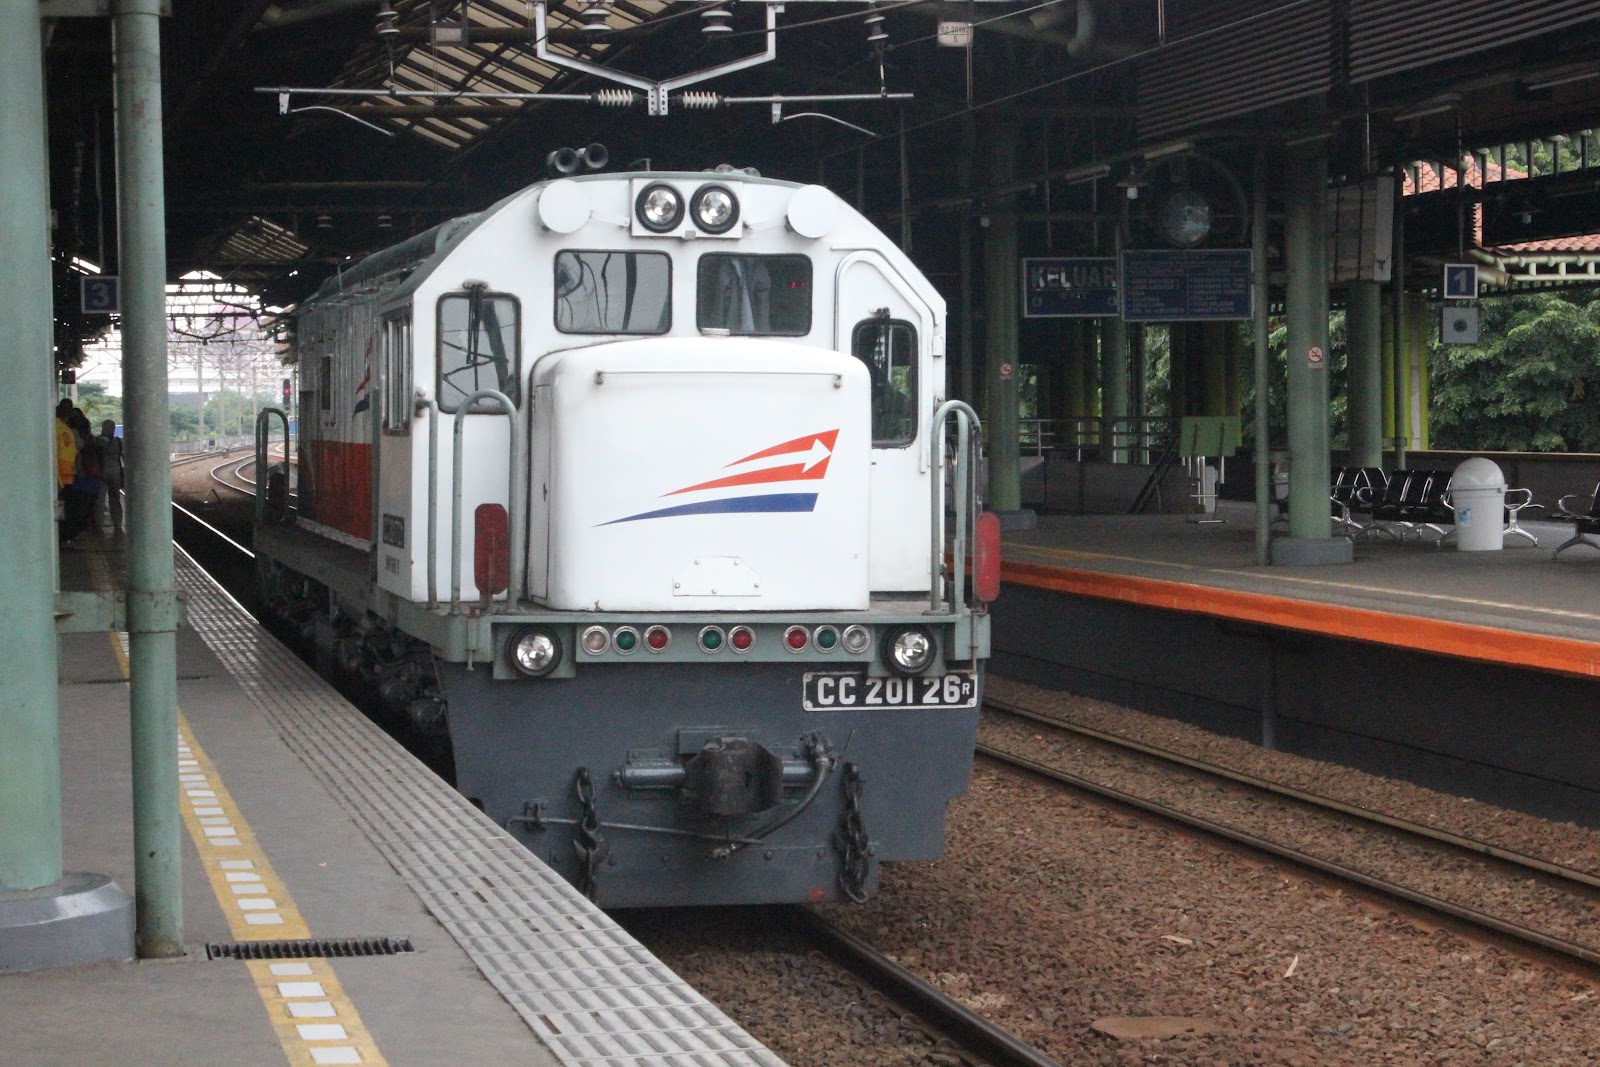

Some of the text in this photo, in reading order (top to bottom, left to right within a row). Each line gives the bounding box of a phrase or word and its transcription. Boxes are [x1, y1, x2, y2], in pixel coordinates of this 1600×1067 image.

[953, 35, 958, 43] 5
[1030, 266, 1117, 288] KELUAR
[1454, 269, 1467, 293] 1
[91, 282, 110, 307] 3
[817, 677, 856, 705] CC
[865, 677, 914, 705] 201
